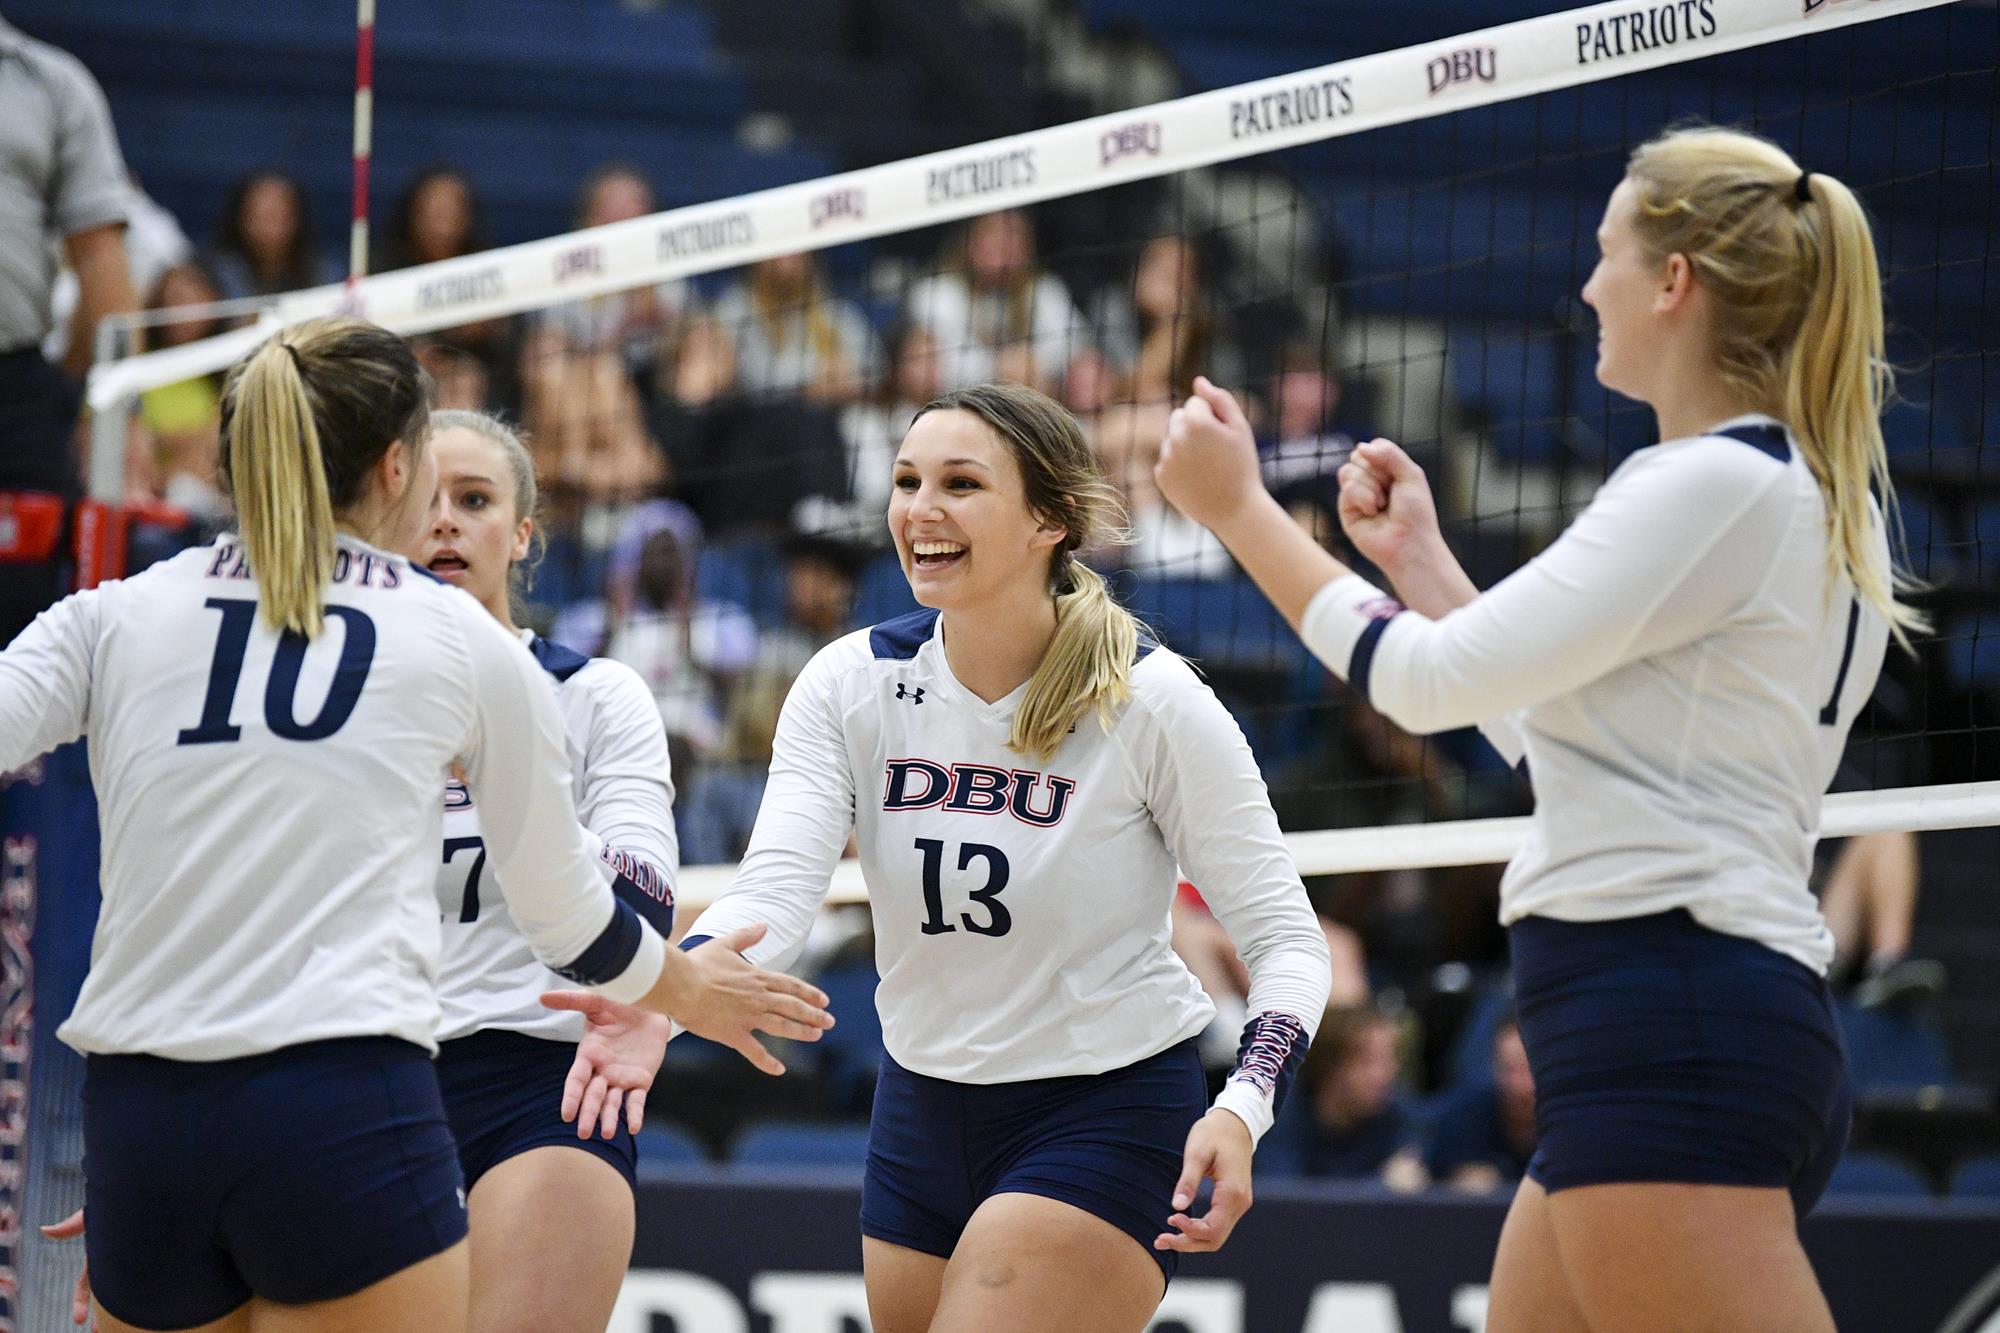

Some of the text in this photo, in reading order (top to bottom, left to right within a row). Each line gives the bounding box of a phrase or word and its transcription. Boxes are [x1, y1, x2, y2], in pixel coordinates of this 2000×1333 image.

[926, 149, 1036, 204] PATRIOTS
[1100, 122, 1161, 166] DBU
[1230, 77, 1354, 139] PATRIOTS
[1426, 46, 1497, 98] DBU
[1577, 0, 1717, 64] PATRIOTS
[205, 543, 402, 590] PAOTS
[177, 597, 377, 746] 10
[882, 757, 1077, 828] DBU
[914, 837, 1012, 938] 13
